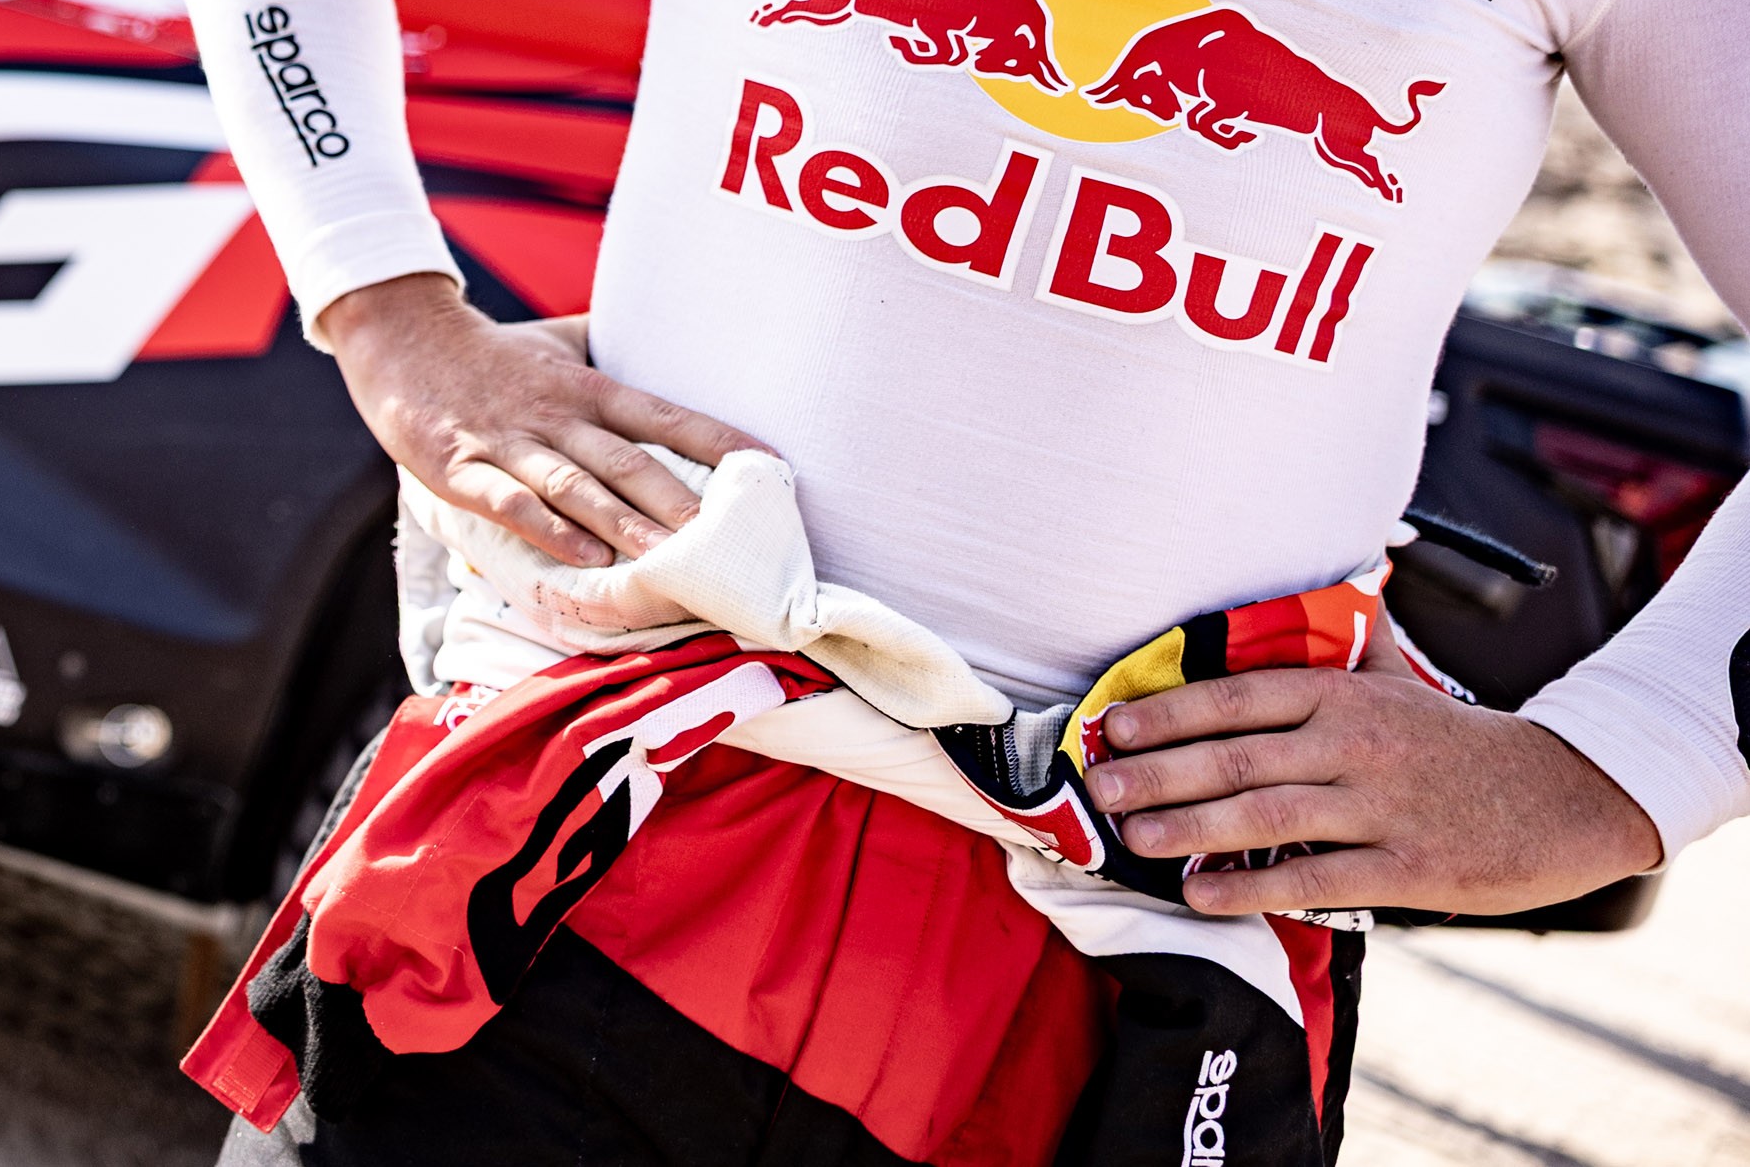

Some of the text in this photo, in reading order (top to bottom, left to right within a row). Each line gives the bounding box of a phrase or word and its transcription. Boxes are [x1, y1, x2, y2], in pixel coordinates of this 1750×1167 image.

[250, 4, 350, 165] sparco
[719, 78, 1377, 362] Red Bull
